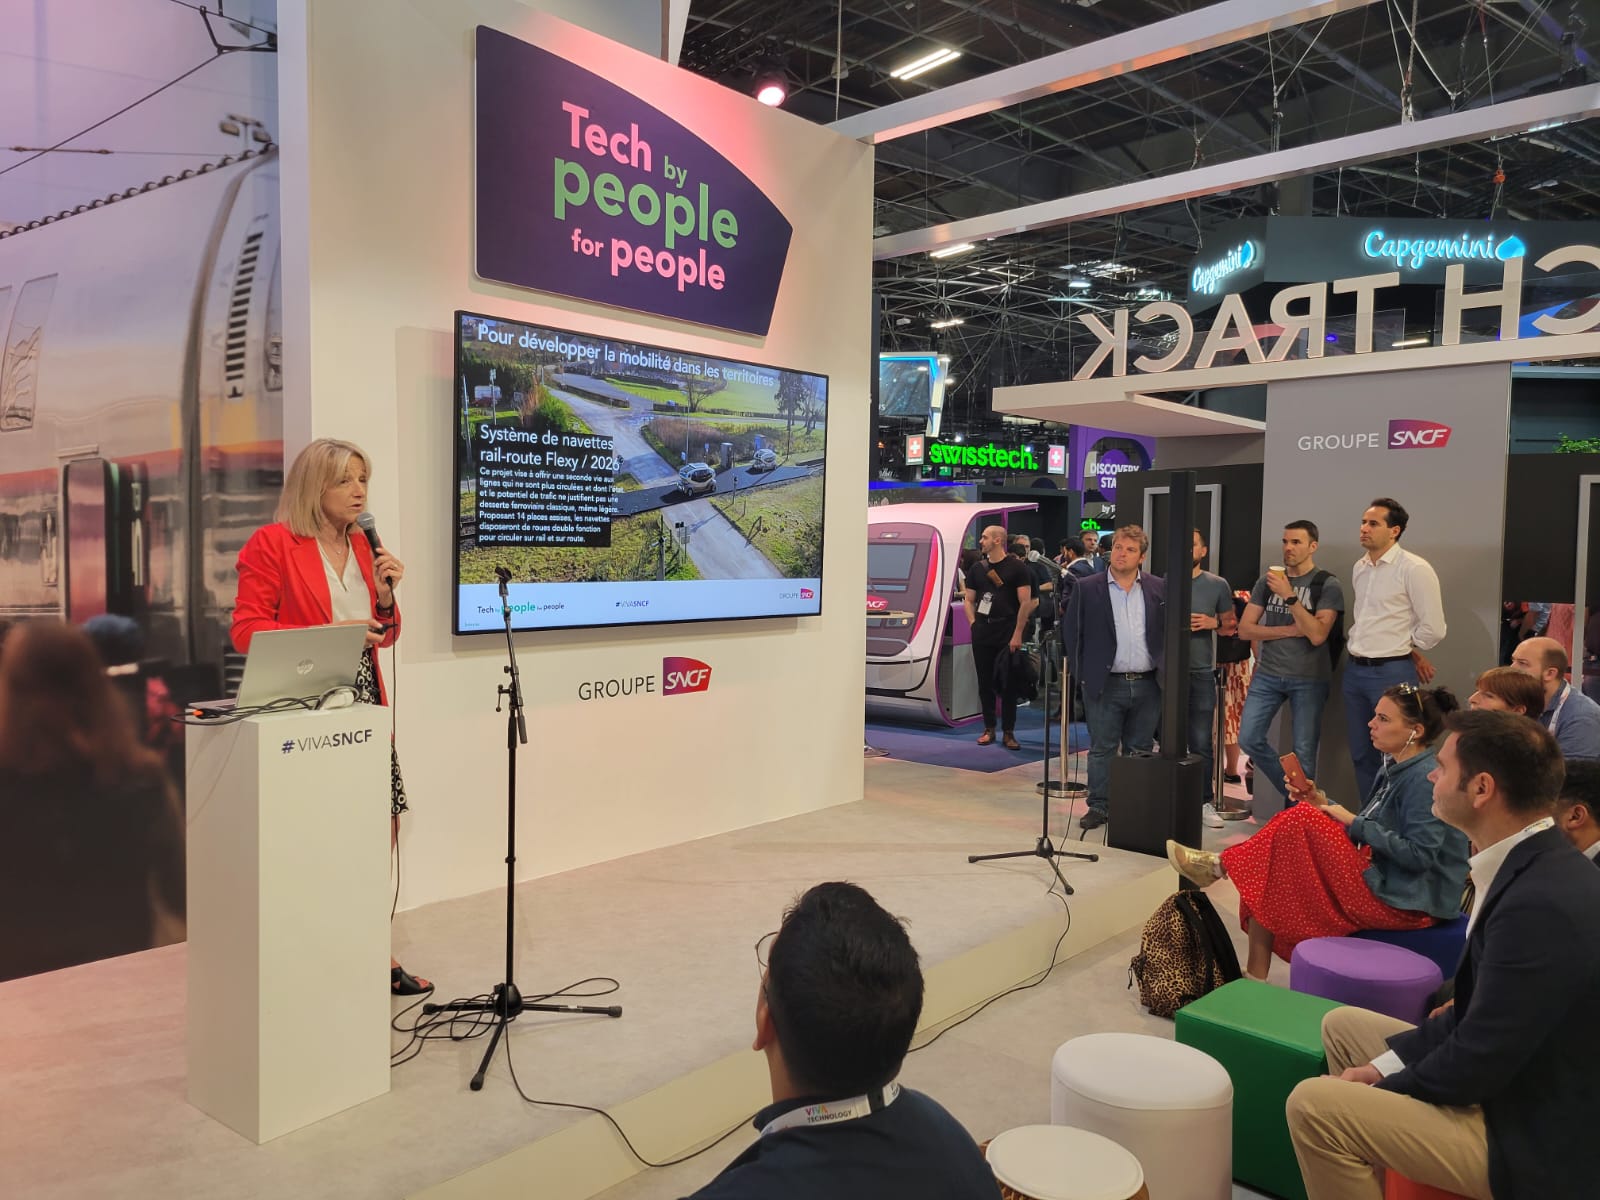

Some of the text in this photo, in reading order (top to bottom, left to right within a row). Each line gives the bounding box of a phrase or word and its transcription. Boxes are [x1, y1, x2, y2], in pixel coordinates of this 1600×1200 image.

[562, 100, 687, 189] Tech by
[554, 156, 739, 250] people
[571, 228, 726, 292] for people
[1364, 230, 1495, 269] Capgemini
[1192, 243, 1242, 295] Capgemini
[478, 323, 774, 386] Pour développer la mobilité dans les territoires
[480, 424, 614, 450] Système de navettes
[1297, 428, 1448, 451] GROUPE SNCF
[480, 447, 620, 472] rail-route Flexy / 2026
[930, 443, 1039, 471] swisstech.
[480, 467, 490, 476] Ce
[492, 469, 513, 479] projet
[514, 470, 527, 478] vise
[535, 471, 551, 479] offrir
[566, 474, 592, 482] seconde
[480, 478, 501, 488] lignes
[502, 480, 514, 489] qui
[525, 481, 540, 489] sont
[541, 481, 555, 490] plus
[556, 482, 584, 491] circulées
[585, 484, 592, 492] et
[593, 483, 608, 492] dont
[480, 500, 510, 509] desserte
[511, 501, 545, 510] ferroviaire
[578, 503, 598, 512] même
[497, 491, 528, 500] potentiel
[529, 491, 539, 499] de
[540, 492, 557, 500] trafic
[567, 492, 595, 502] justifient
[595, 496, 607, 504] pas
[479, 522, 520, 533] disposeront
[522, 522, 531, 531] de
[552, 523, 574, 532] double
[576, 523, 601, 533] fonction
[480, 511, 515, 521] Proposant
[517, 511, 525, 520] 14
[527, 512, 547, 522] places
[574, 513, 583, 522] les
[584, 515, 610, 523] navettes
[479, 534, 496, 543] pour
[497, 532, 522, 541] circuler
[536, 533, 546, 541] rail
[547, 534, 554, 542] et
[477, 604, 494, 614] Tech
[543, 602, 565, 612] people
[578, 668, 709, 701] GROUPE SNCF
[281, 729, 373, 754] #VIVASNCF
[807, 1110, 852, 1123] TECHNOLOGY
